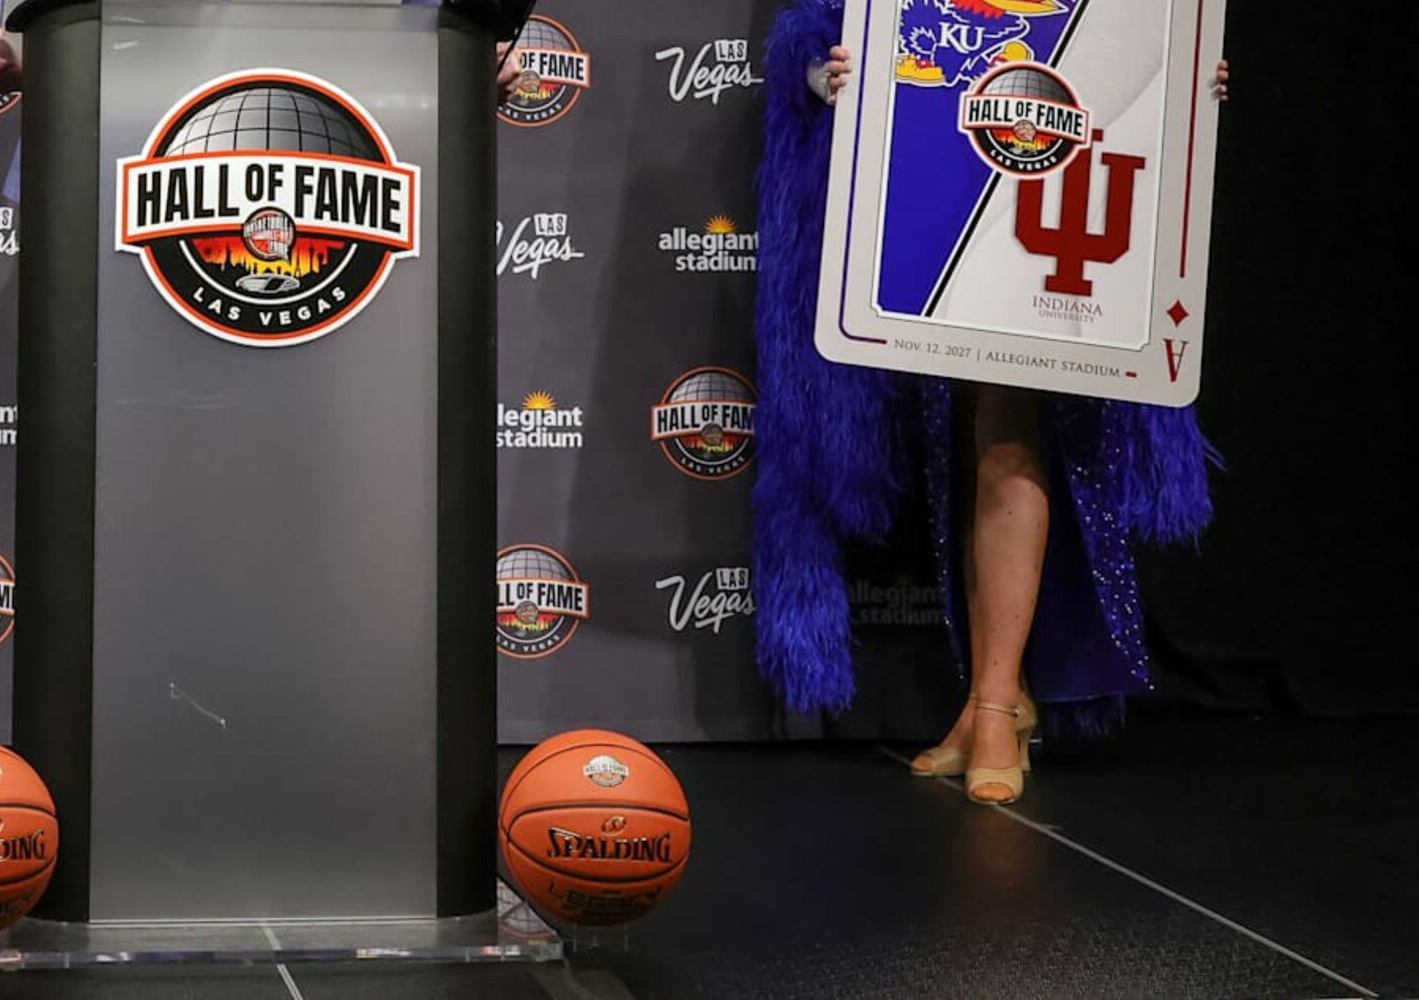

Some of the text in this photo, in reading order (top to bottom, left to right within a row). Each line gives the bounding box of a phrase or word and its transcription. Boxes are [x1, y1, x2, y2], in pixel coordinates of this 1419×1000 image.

[715, 41, 747, 61] LAS
[938, 21, 985, 53] KU
[539, 53, 583, 81] FAME
[655, 43, 764, 104] Vegas
[968, 99, 1083, 137] HALL OF FAME
[990, 150, 1056, 171] LAS VEGAS
[137, 164, 401, 233] HALL OF FAME
[534, 214, 566, 234] LAS
[193, 286, 346, 326] LAS VEGAS
[1032, 295, 1103, 316] INDIANA
[945, 345, 971, 358] 2027
[986, 351, 1055, 370] ALLEGIANT
[1060, 361, 1120, 378] STADIUM
[1163, 338, 1189, 383] A
[497, 403, 583, 431] legiant
[657, 405, 755, 433] HALL OF FAM
[496, 427, 583, 448] stadium
[717, 569, 748, 589] LAS
[516, 583, 534, 600] OF
[537, 583, 582, 611] FAME
[548, 827, 671, 864] SPALDING
